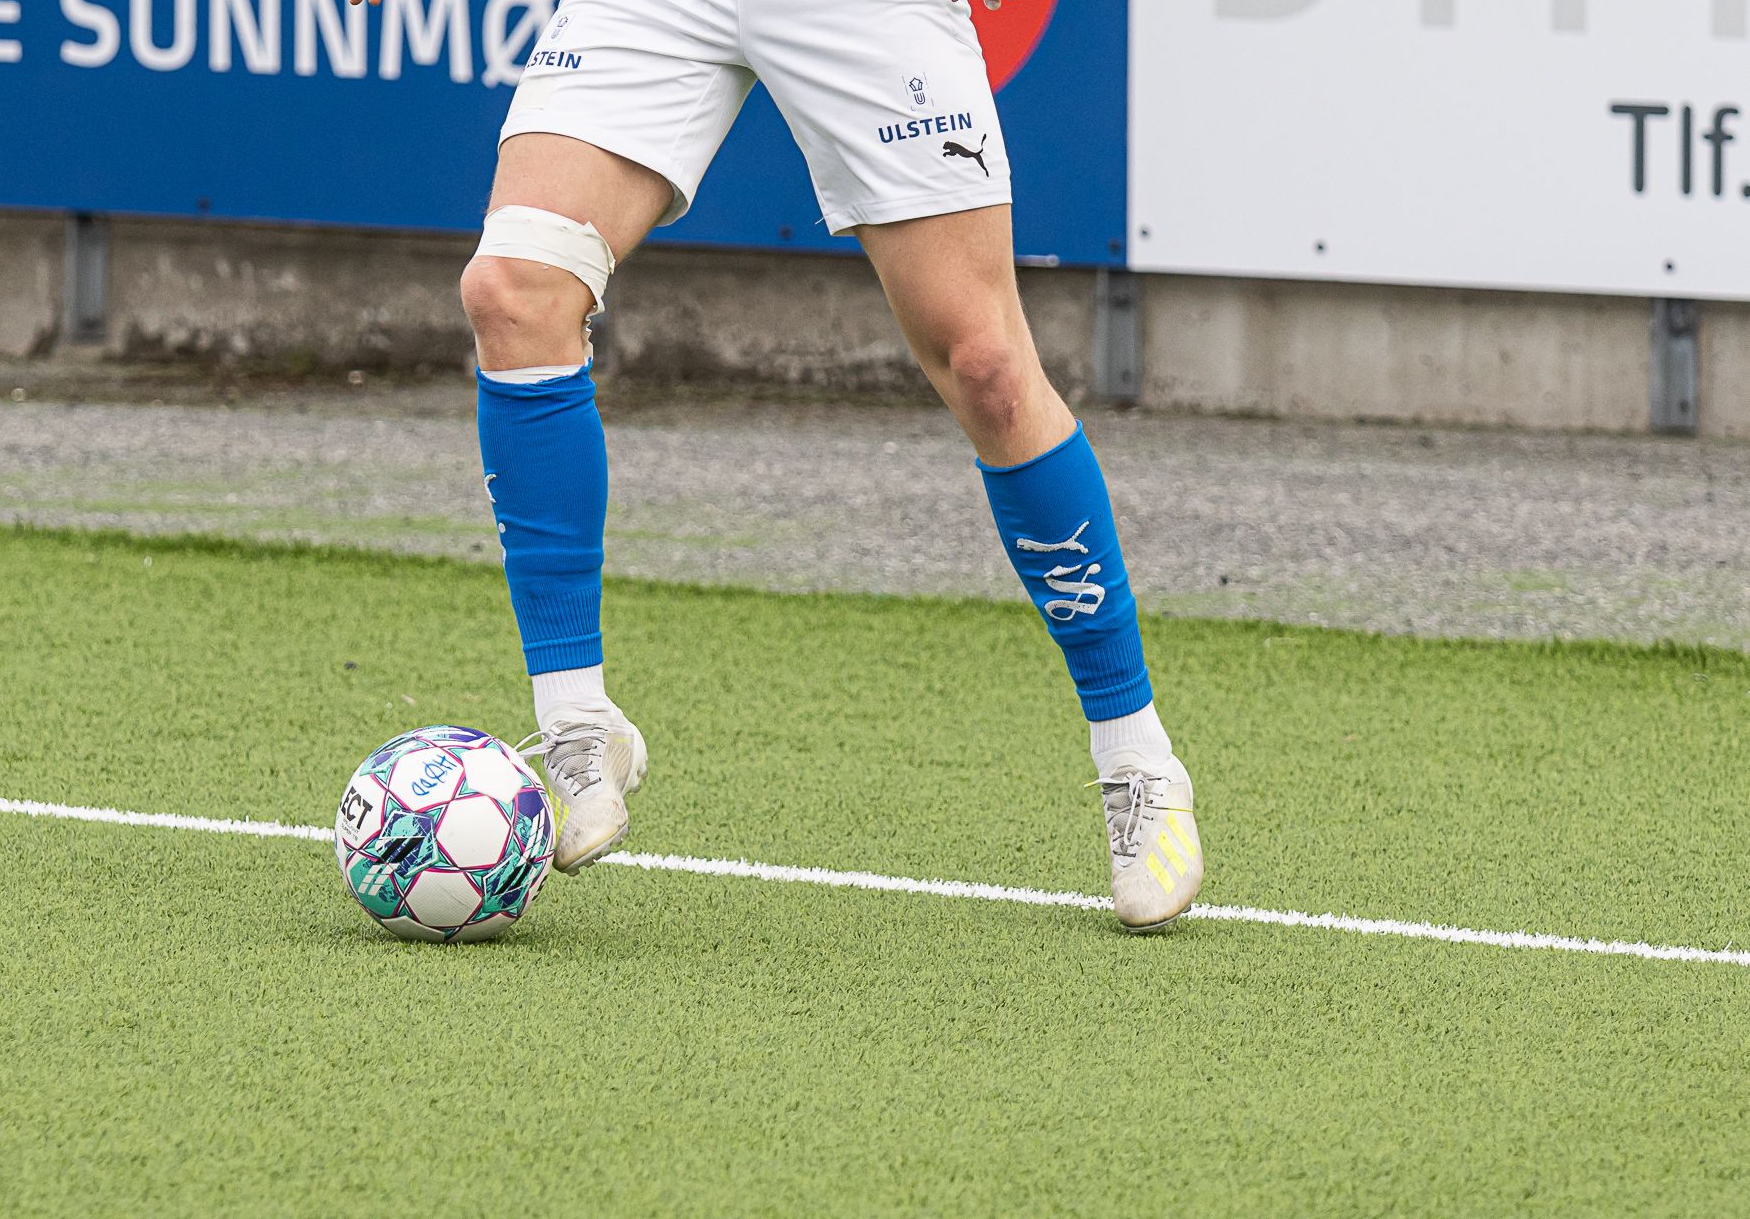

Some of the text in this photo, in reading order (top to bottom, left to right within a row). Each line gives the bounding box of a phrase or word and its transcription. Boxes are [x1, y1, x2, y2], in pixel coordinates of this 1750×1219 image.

[526, 51, 582, 69] STEIN
[878, 112, 973, 143] ULSTEIN
[340, 785, 374, 830] ECT
